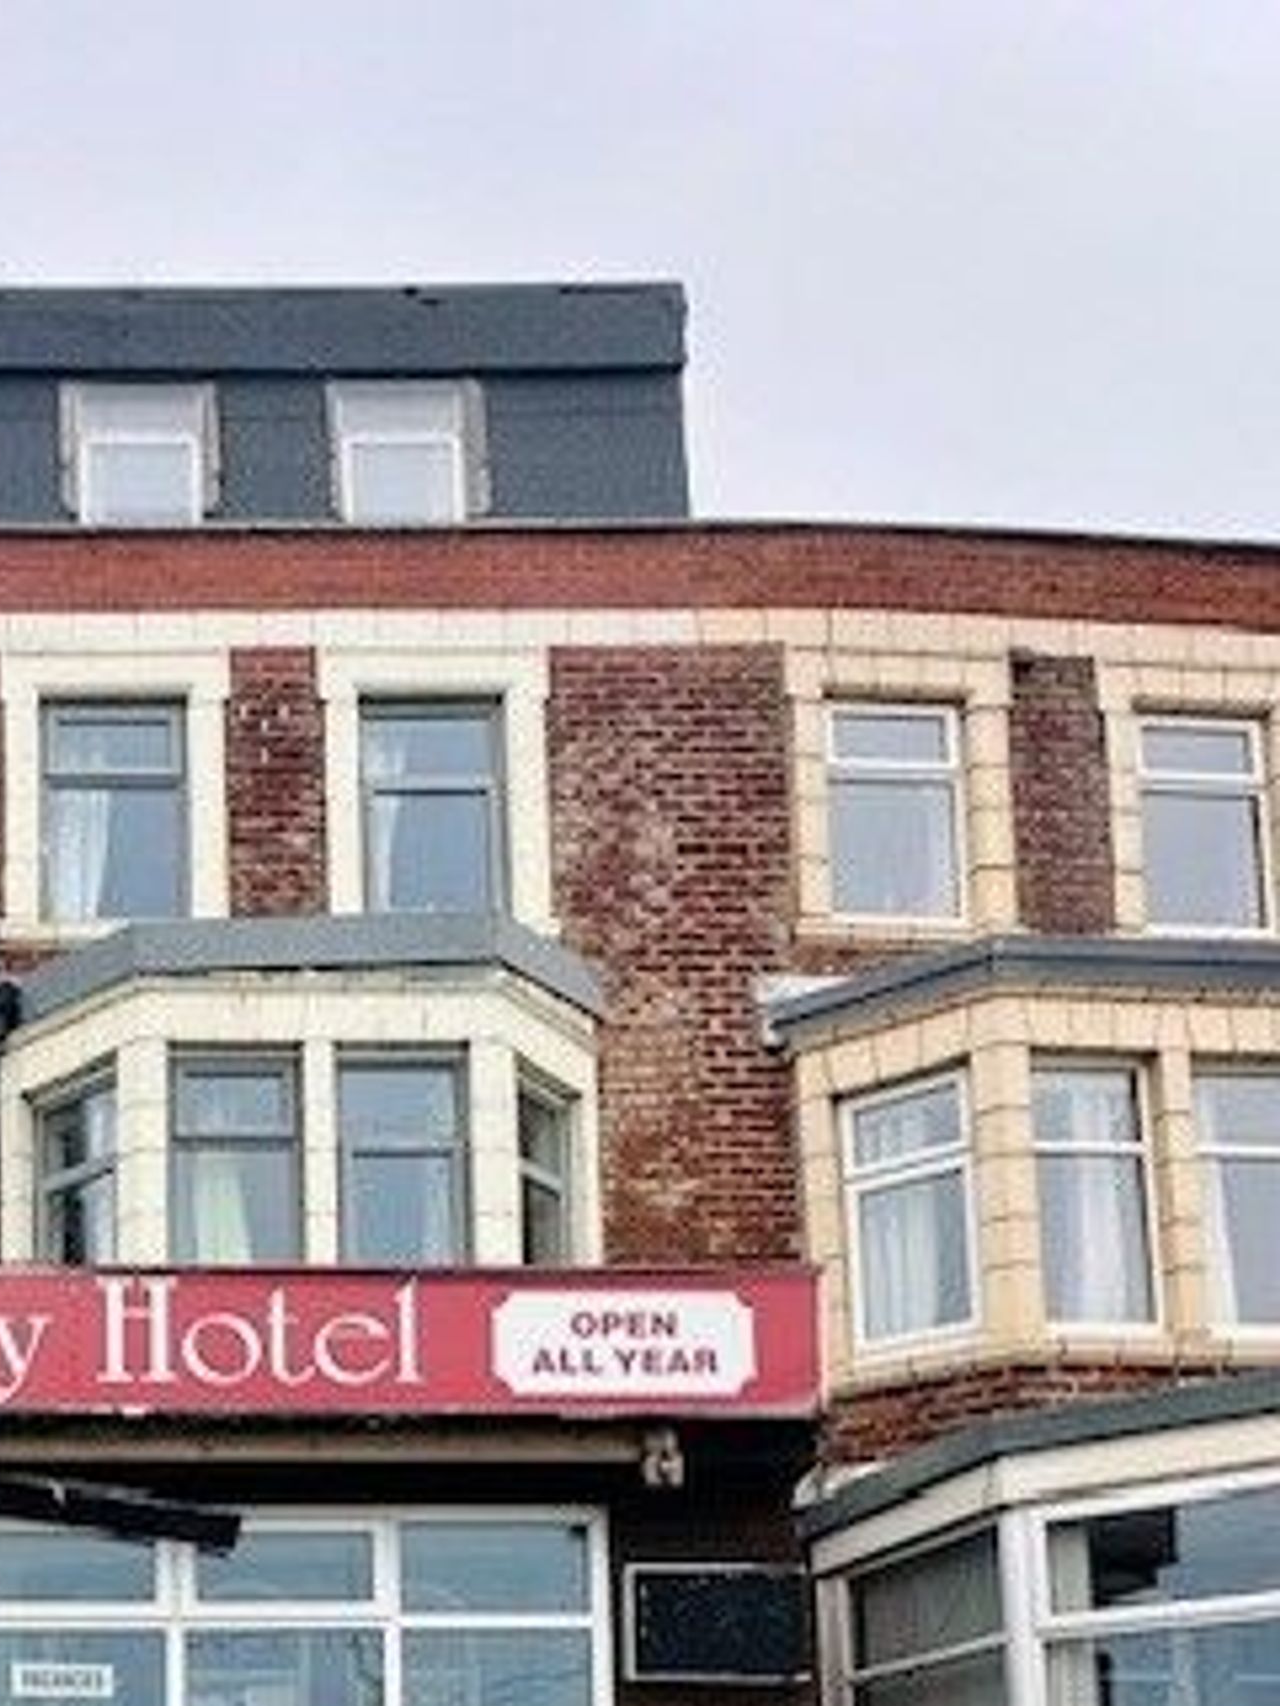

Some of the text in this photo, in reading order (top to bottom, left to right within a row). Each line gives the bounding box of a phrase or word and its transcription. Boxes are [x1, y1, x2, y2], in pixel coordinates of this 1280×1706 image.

[96, 1275, 422, 1386] Hotel
[571, 1311, 678, 1339] OPEN
[532, 1347, 719, 1376] ALL YEAR
